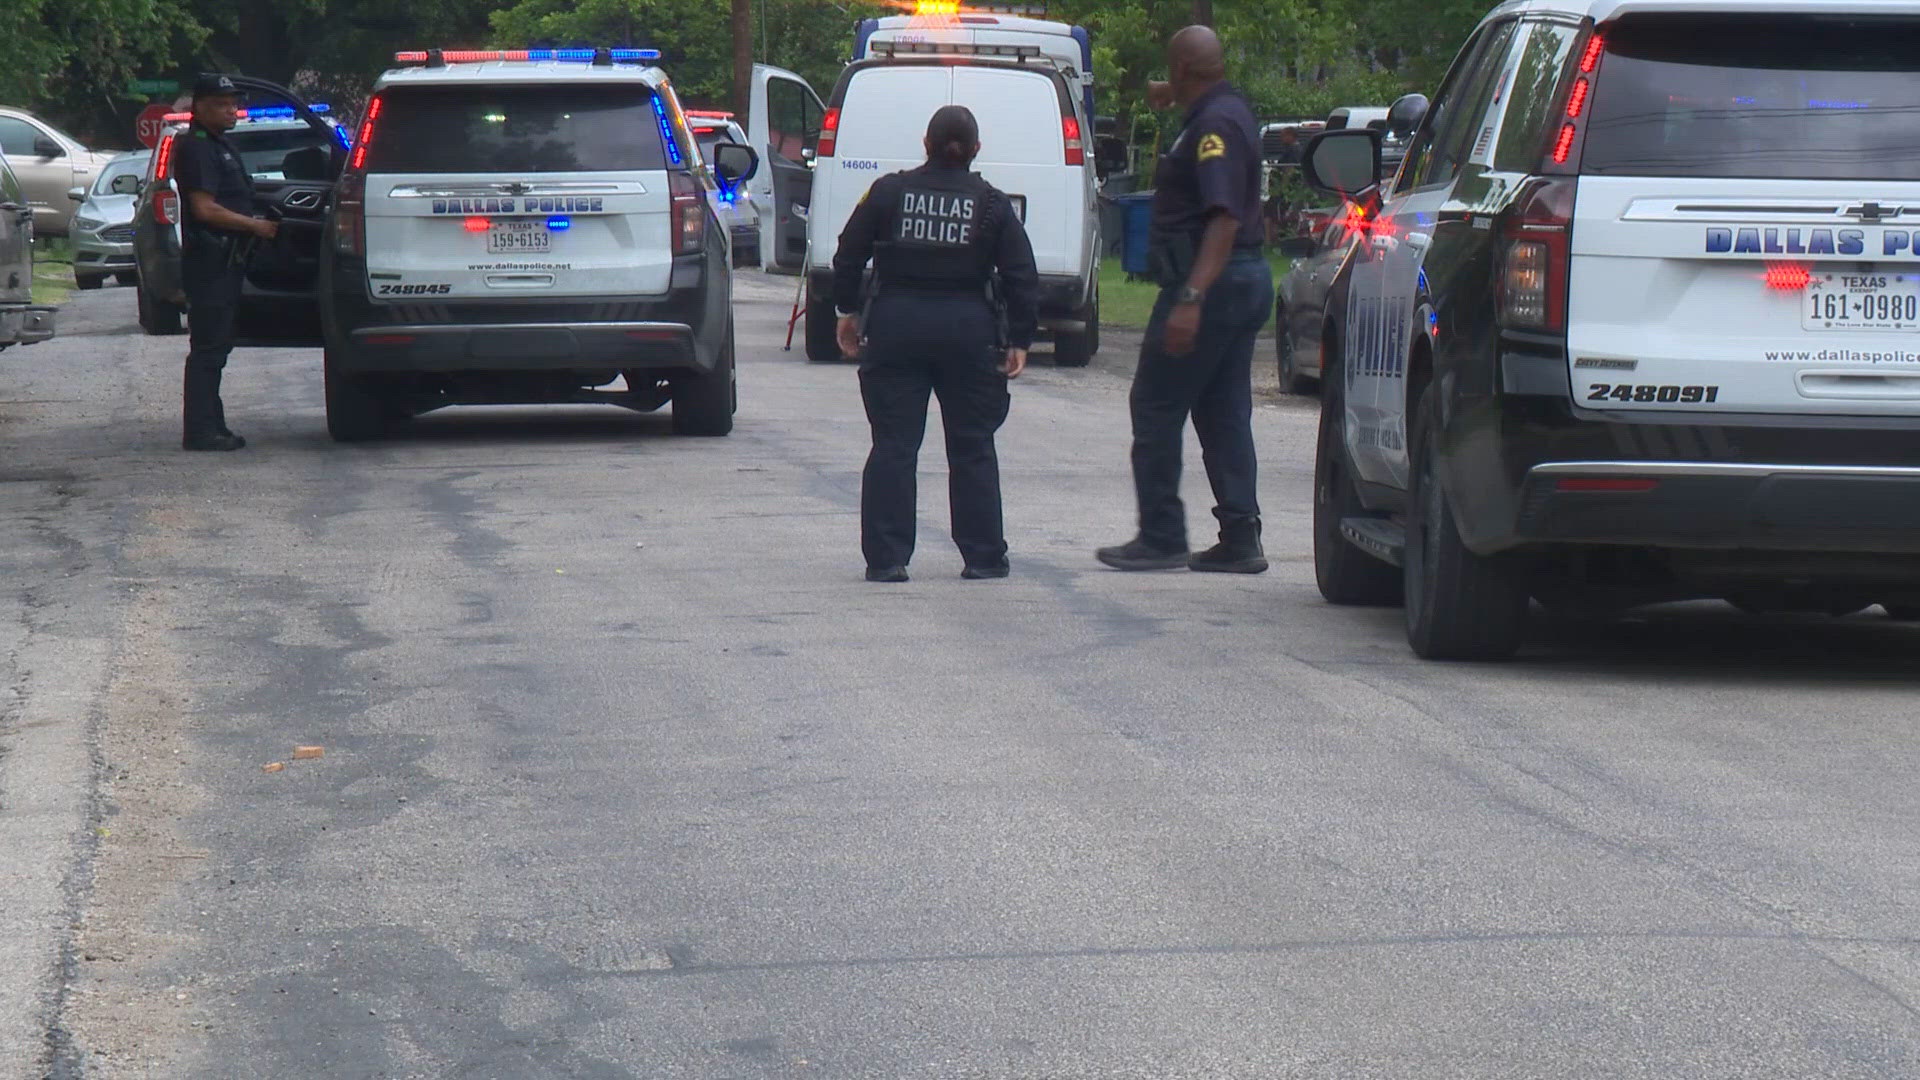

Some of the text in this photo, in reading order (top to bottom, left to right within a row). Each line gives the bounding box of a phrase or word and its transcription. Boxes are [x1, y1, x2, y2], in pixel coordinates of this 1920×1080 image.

[842, 160, 878, 170] 146004
[433, 197, 603, 214] DALLAS POLICE
[903, 193, 974, 220] DALLAS
[901, 218, 971, 244] POLICE
[1706, 227, 1864, 255] DALLAS
[468, 262, 571, 270] www.dallaspolice.net
[379, 284, 452, 295] 248045
[1841, 276, 1887, 288] TEXAS
[1588, 384, 1719, 402] 248091
